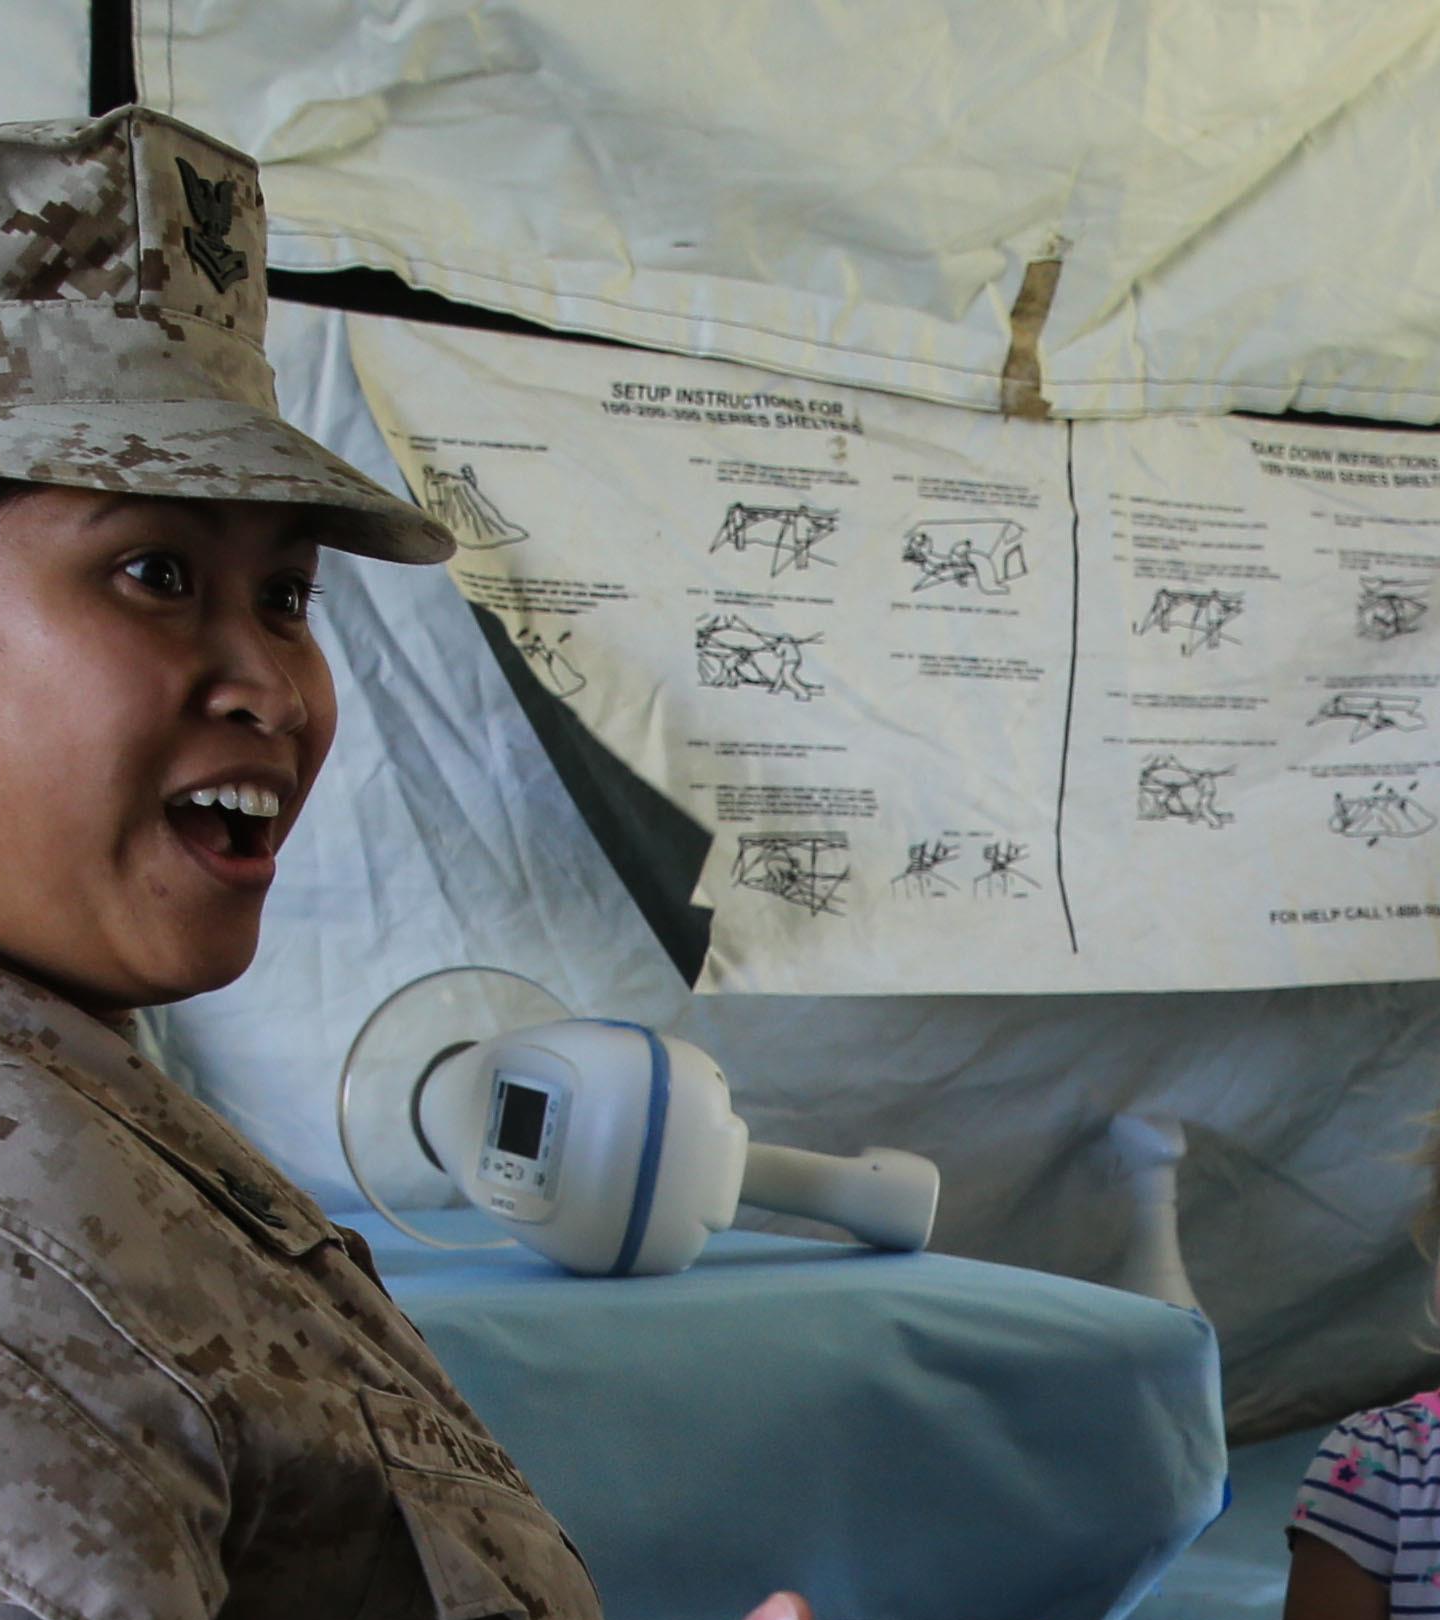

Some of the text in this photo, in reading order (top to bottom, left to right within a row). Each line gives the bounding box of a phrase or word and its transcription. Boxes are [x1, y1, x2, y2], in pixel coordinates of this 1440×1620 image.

[612, 382, 844, 417] SETUP INSTRUCTIONS FOR
[705, 411, 770, 428] SERIES
[775, 412, 864, 435] SHELTERS
[1269, 909, 1298, 925] FOR
[1301, 907, 1341, 924] HELP
[1345, 905, 1382, 921] CALL
